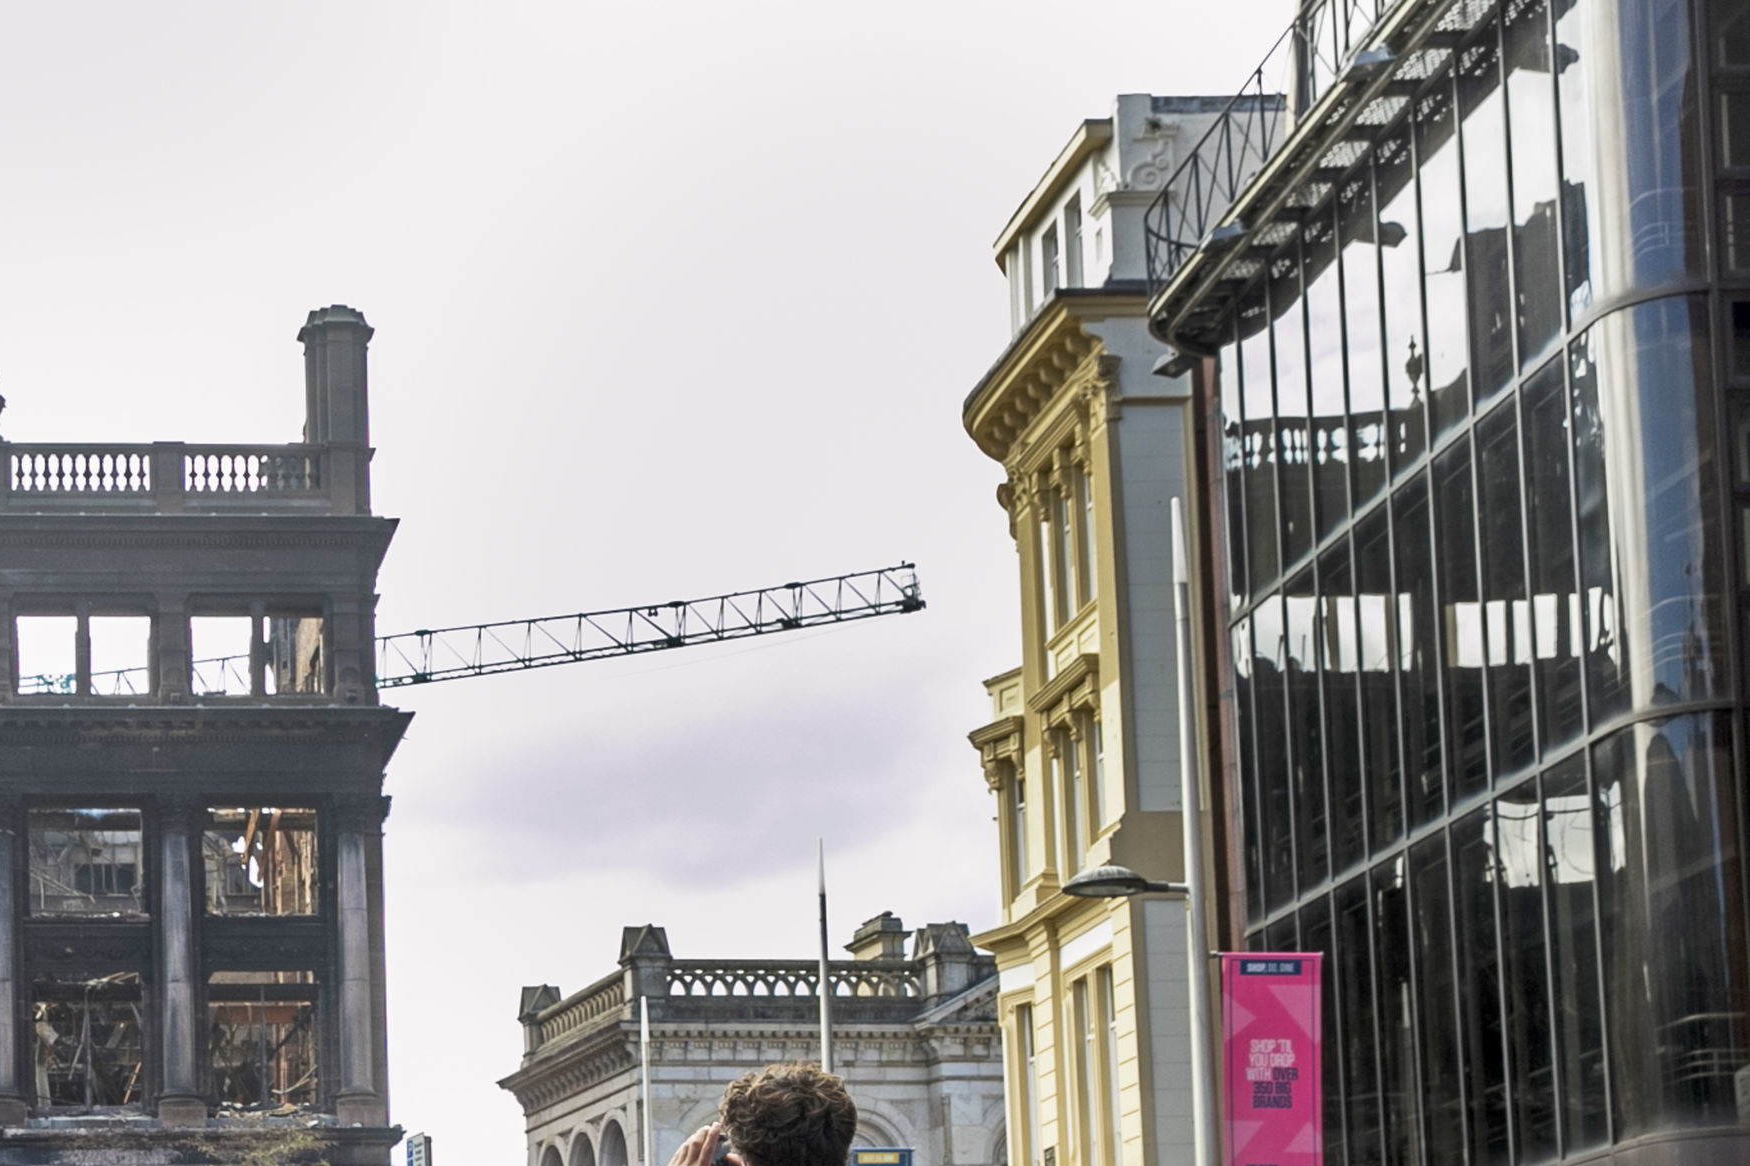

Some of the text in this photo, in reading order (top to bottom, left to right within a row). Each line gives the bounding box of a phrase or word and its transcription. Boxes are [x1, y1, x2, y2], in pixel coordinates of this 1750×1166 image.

[1250, 1039, 1276, 1052] SHOP
[1249, 1053, 1295, 1067] YOU DROP
[1246, 1067, 1298, 1081] WITH OVER
[1253, 1081, 1292, 1095] 350 BIG
[1253, 1095, 1292, 1109] BRANDS
